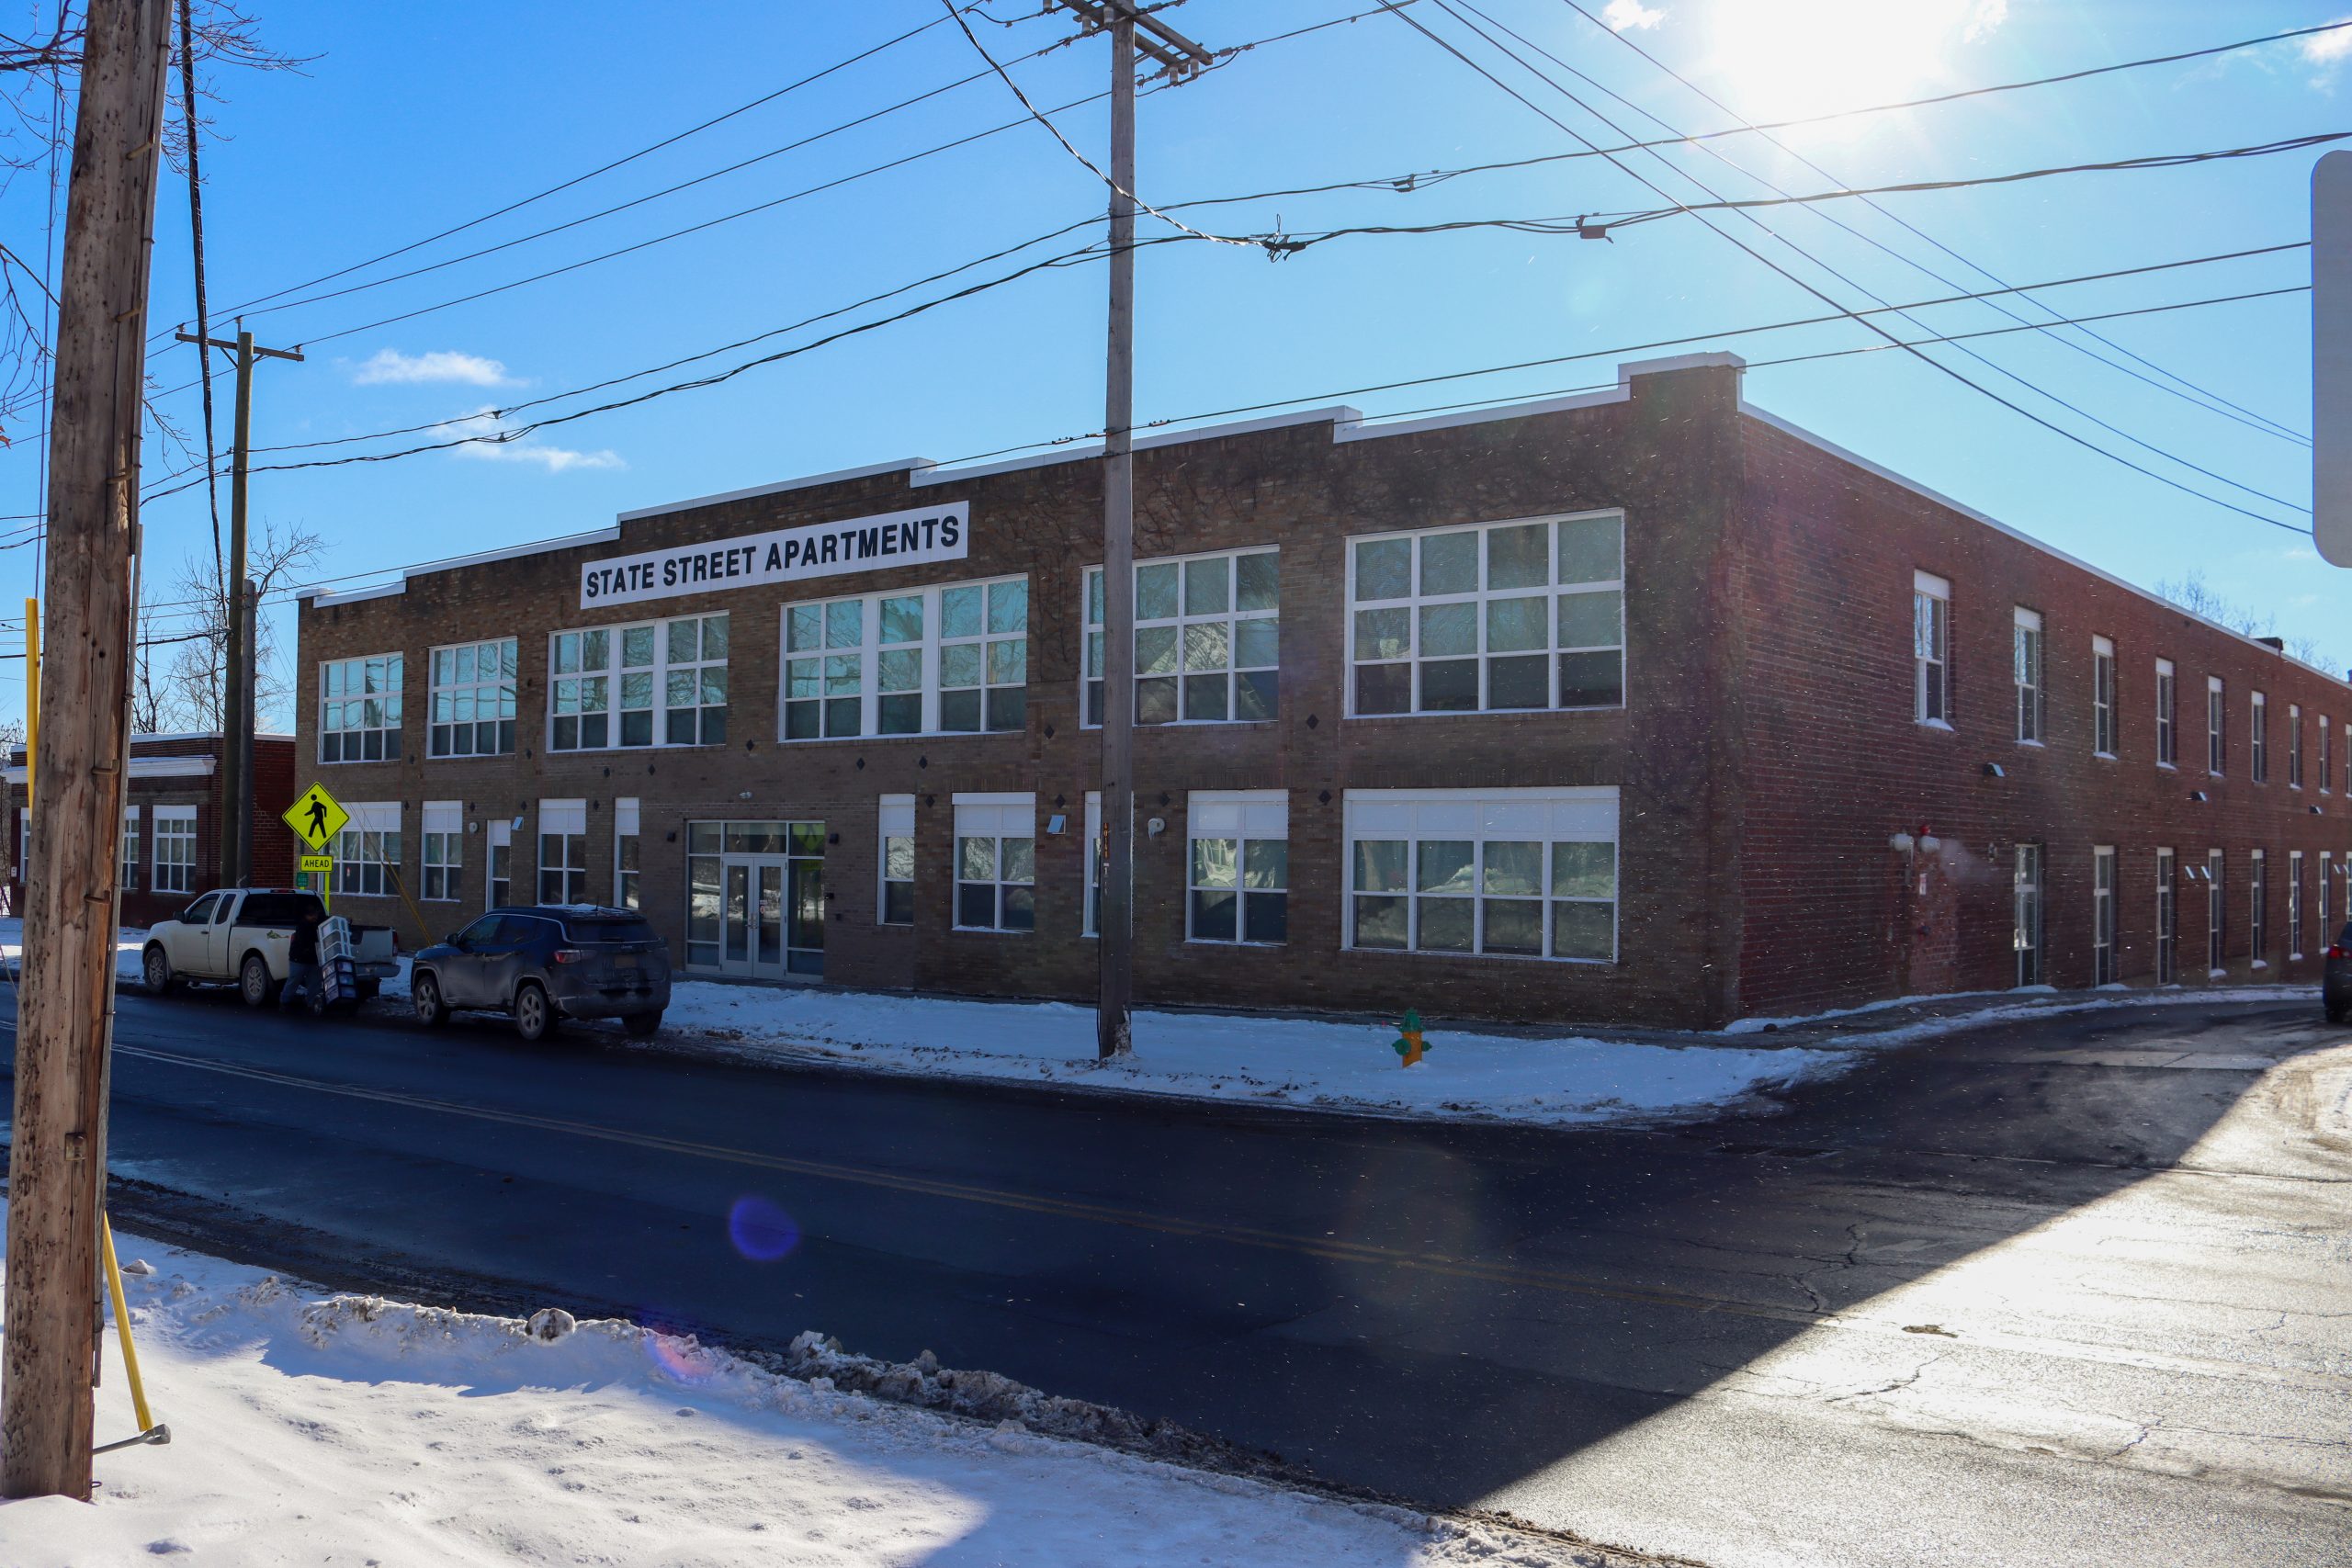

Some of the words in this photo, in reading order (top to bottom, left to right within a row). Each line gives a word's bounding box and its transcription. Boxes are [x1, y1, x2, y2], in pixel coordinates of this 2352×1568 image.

[586, 562, 655, 598] STATE
[662, 546, 757, 587] STREET
[764, 515, 959, 572] APARTMENTS
[304, 859, 330, 868] AHEAD
